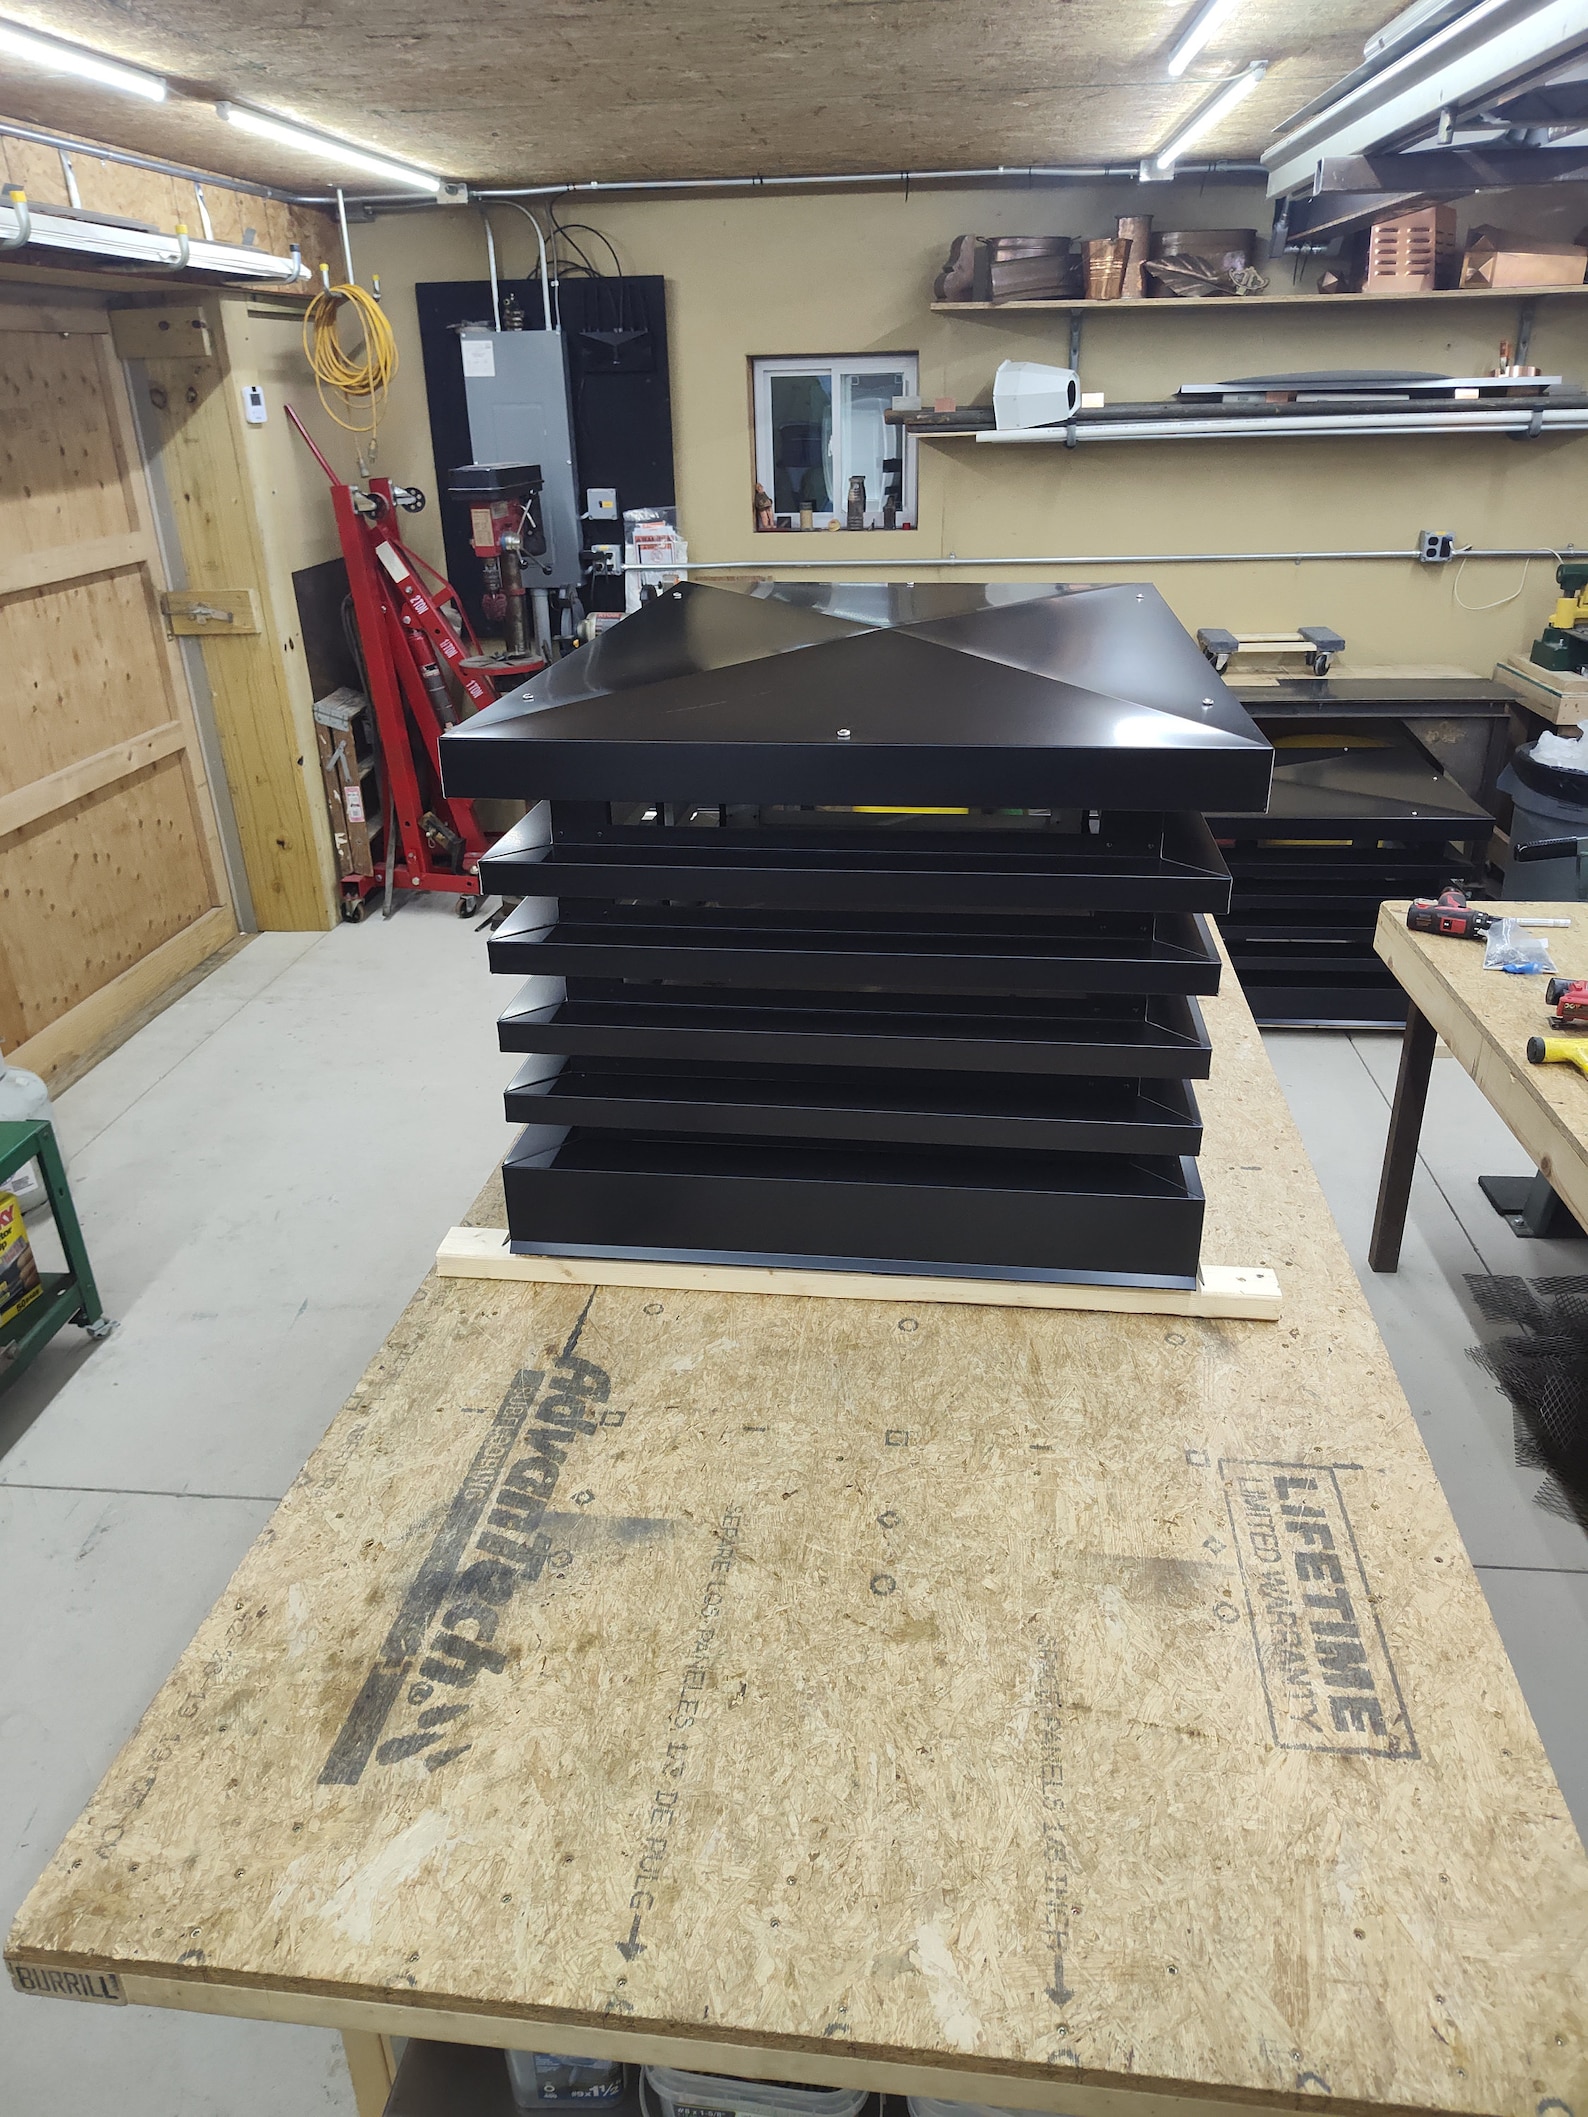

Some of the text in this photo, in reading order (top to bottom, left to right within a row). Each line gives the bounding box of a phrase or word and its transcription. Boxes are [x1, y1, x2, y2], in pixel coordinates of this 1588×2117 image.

[710, 1504, 745, 1573] SEPARE
[1237, 1476, 1324, 1733] LIMITED WARRANTY
[1273, 1475, 1388, 1737] LIFETIME
[650, 1790, 679, 1827] DE
[629, 1837, 668, 1910] PULG
[16, 1966, 119, 1999] BURRILL
